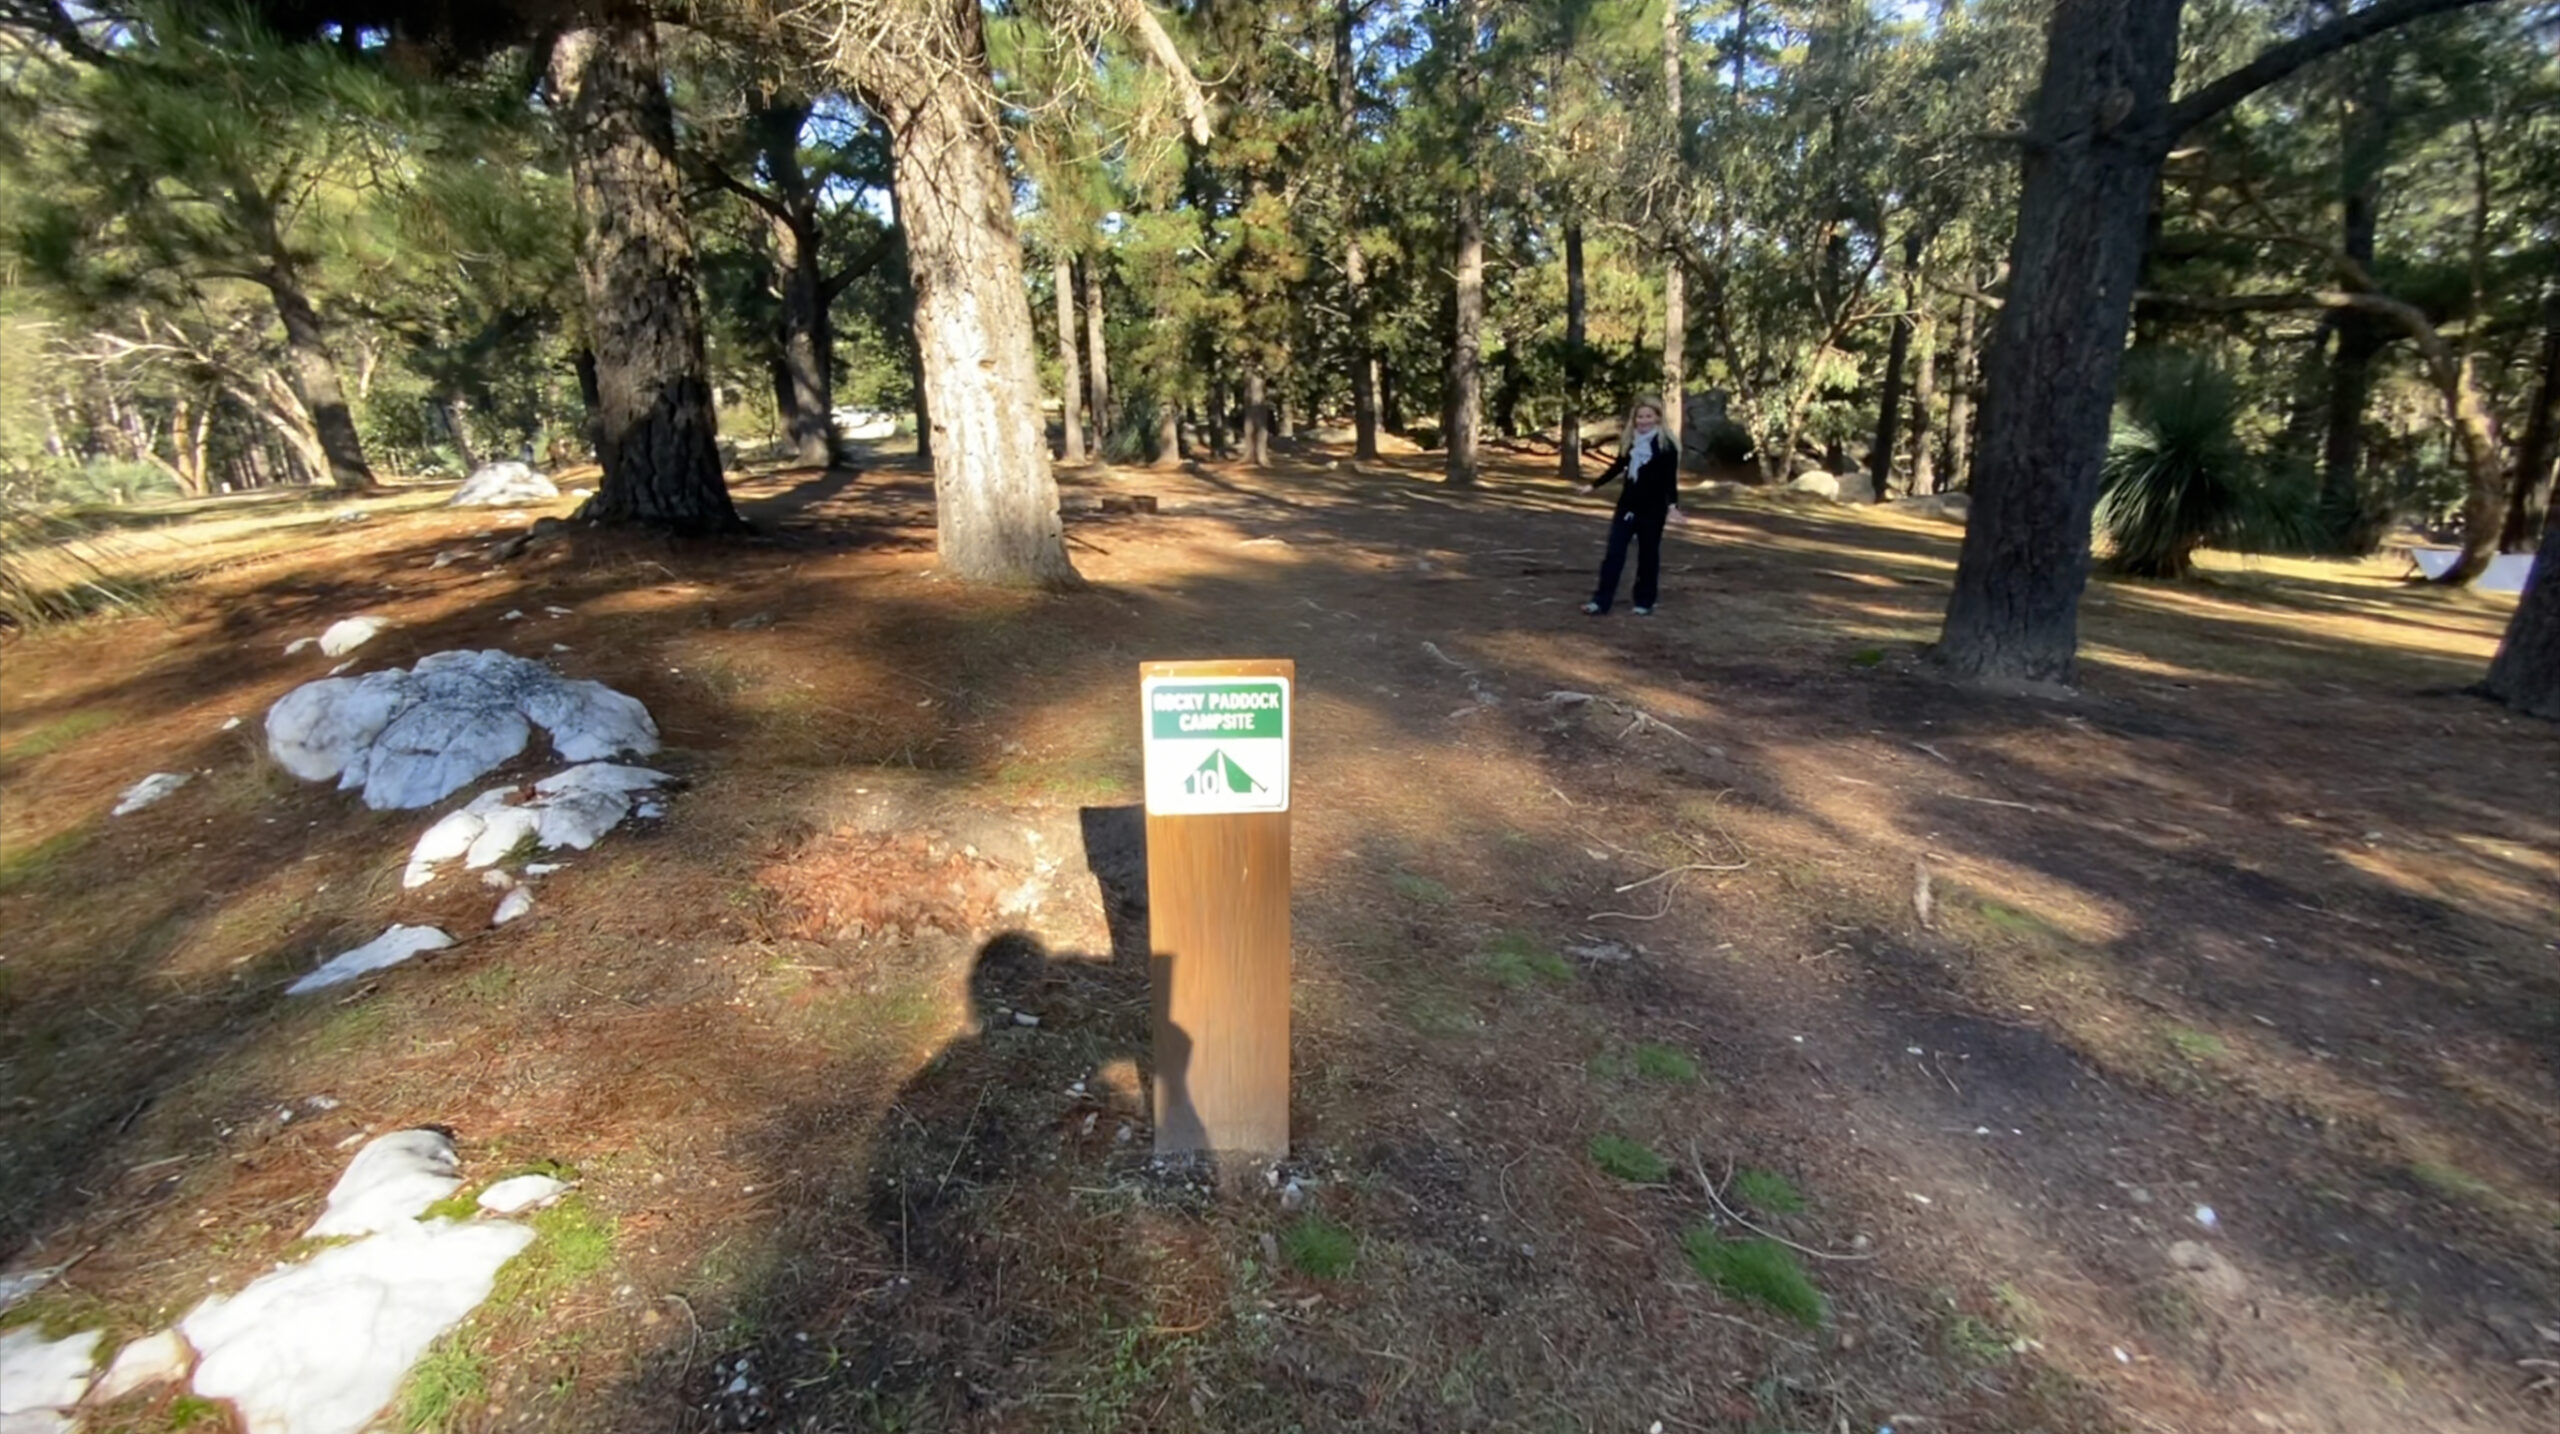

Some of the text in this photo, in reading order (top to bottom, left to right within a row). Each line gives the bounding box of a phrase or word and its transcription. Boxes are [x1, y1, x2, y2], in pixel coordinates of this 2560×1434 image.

[1208, 692, 1280, 710] PADDOCK
[1178, 713, 1255, 732] CAMPSITE
[1193, 769, 1219, 795] 10
